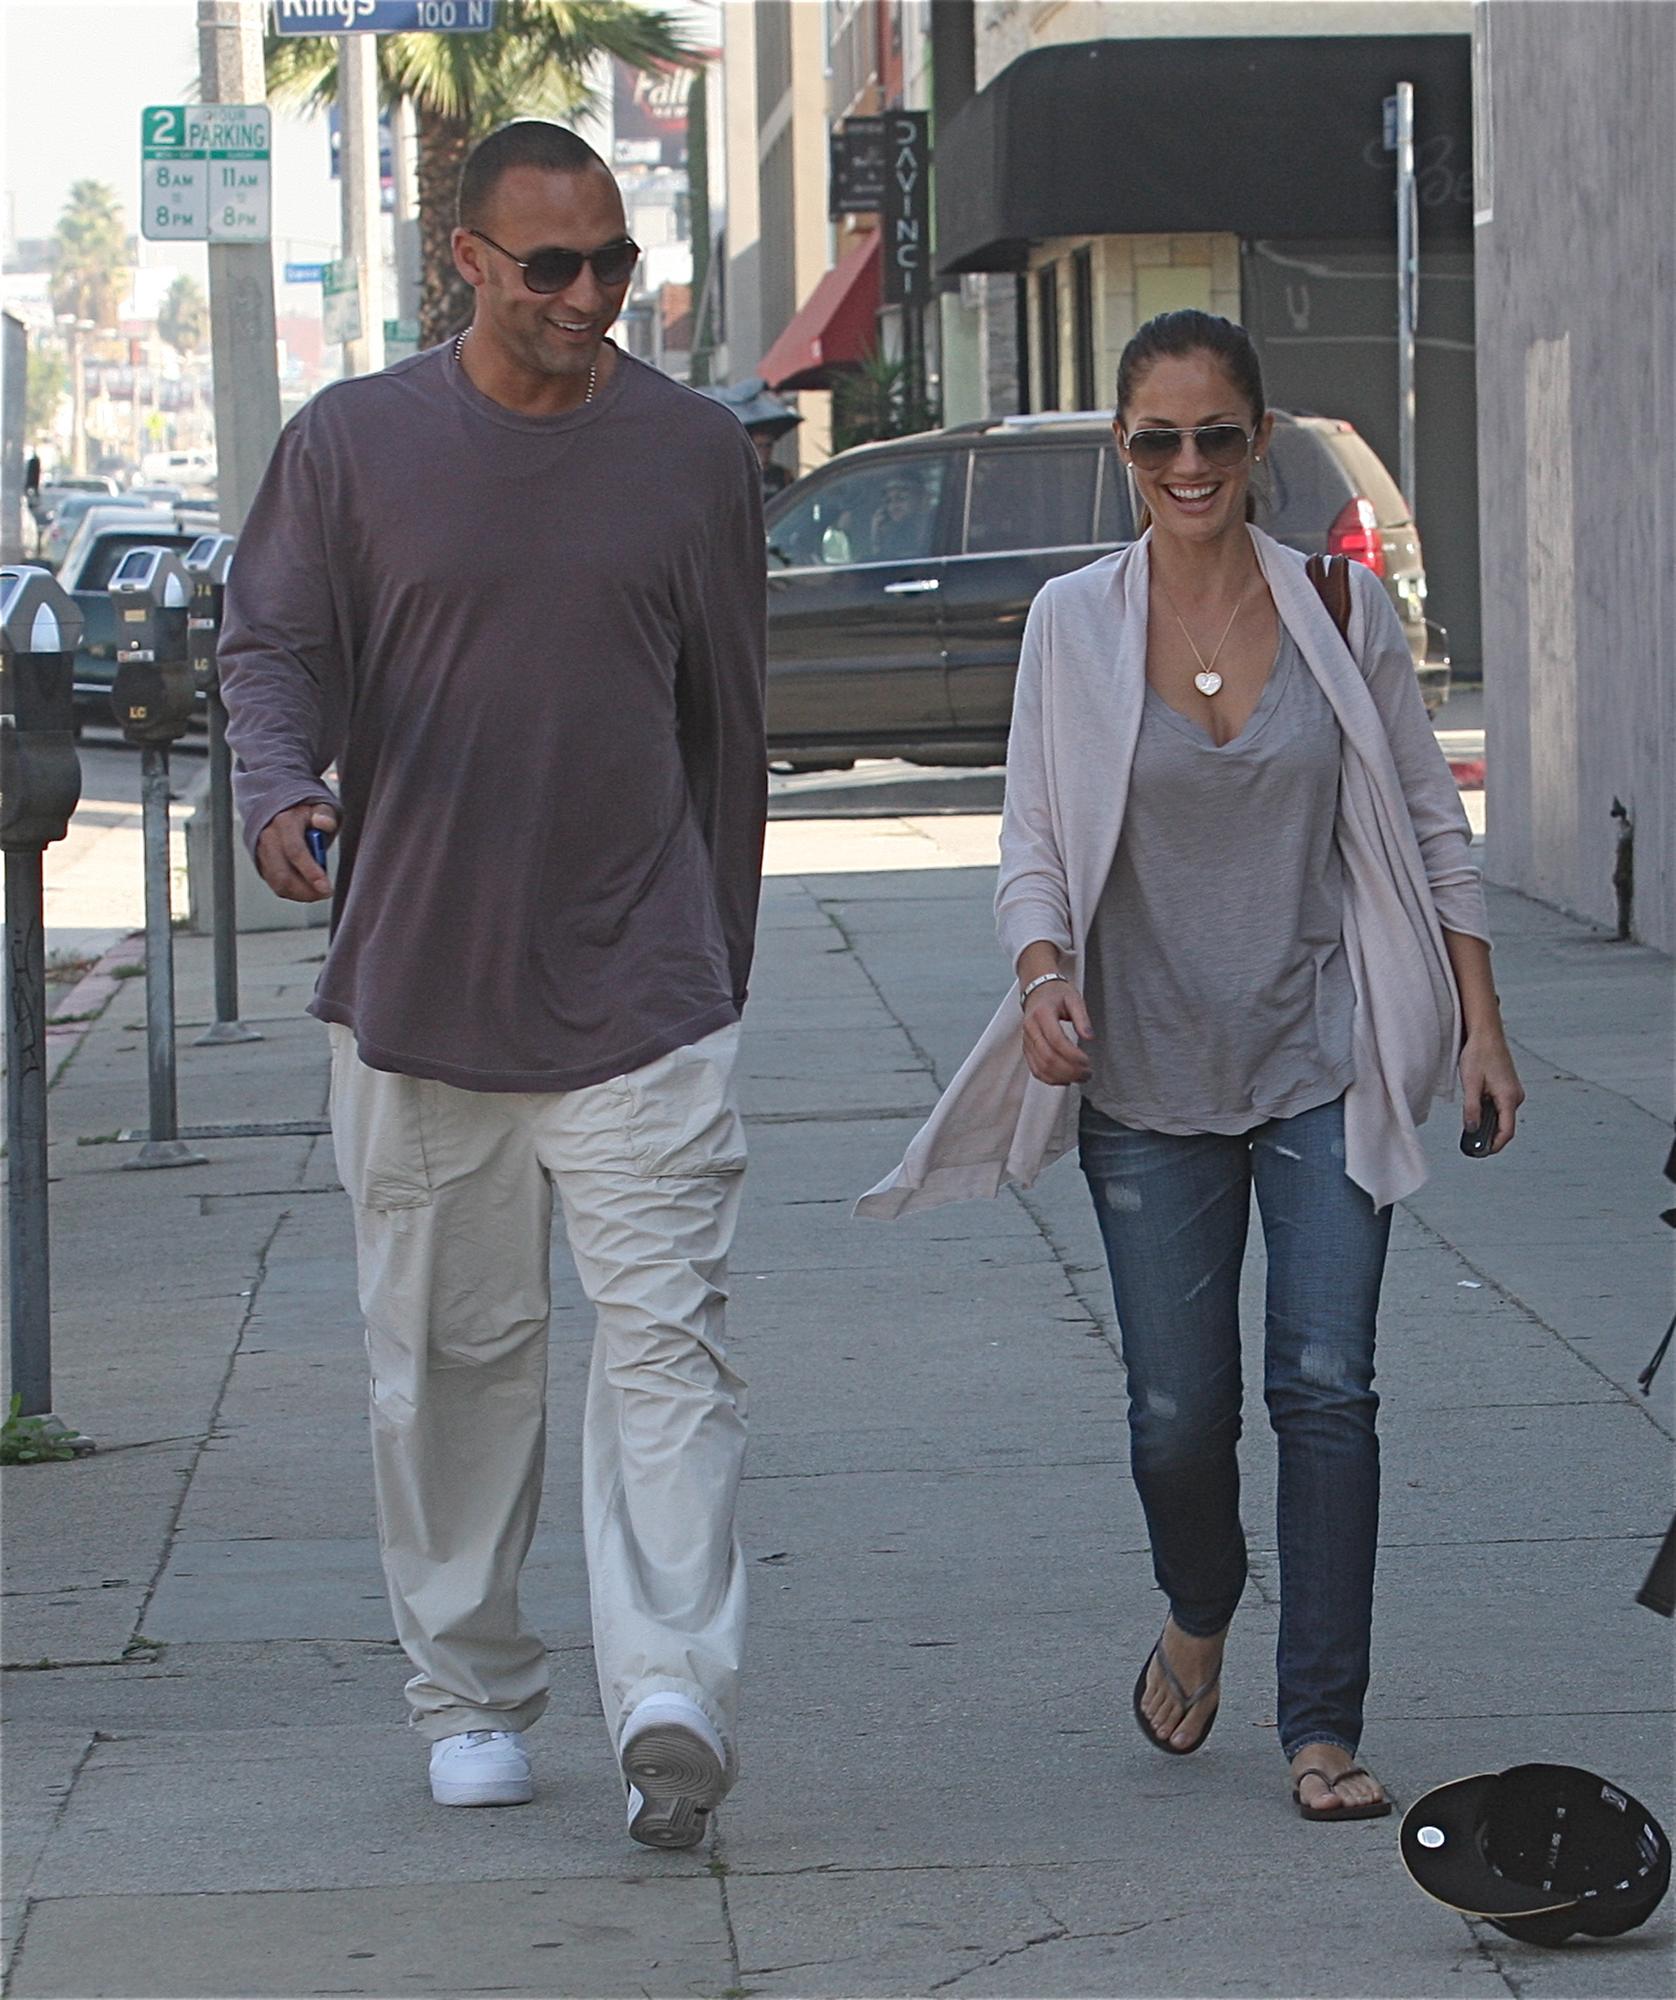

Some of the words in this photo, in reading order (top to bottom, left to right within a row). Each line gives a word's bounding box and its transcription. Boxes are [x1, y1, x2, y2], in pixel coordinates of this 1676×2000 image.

[416, 1, 457, 27] 100
[468, 1, 484, 25] N
[152, 110, 176, 144] 2
[189, 123, 265, 148] PARKING
[129, 706, 147, 719] LC
